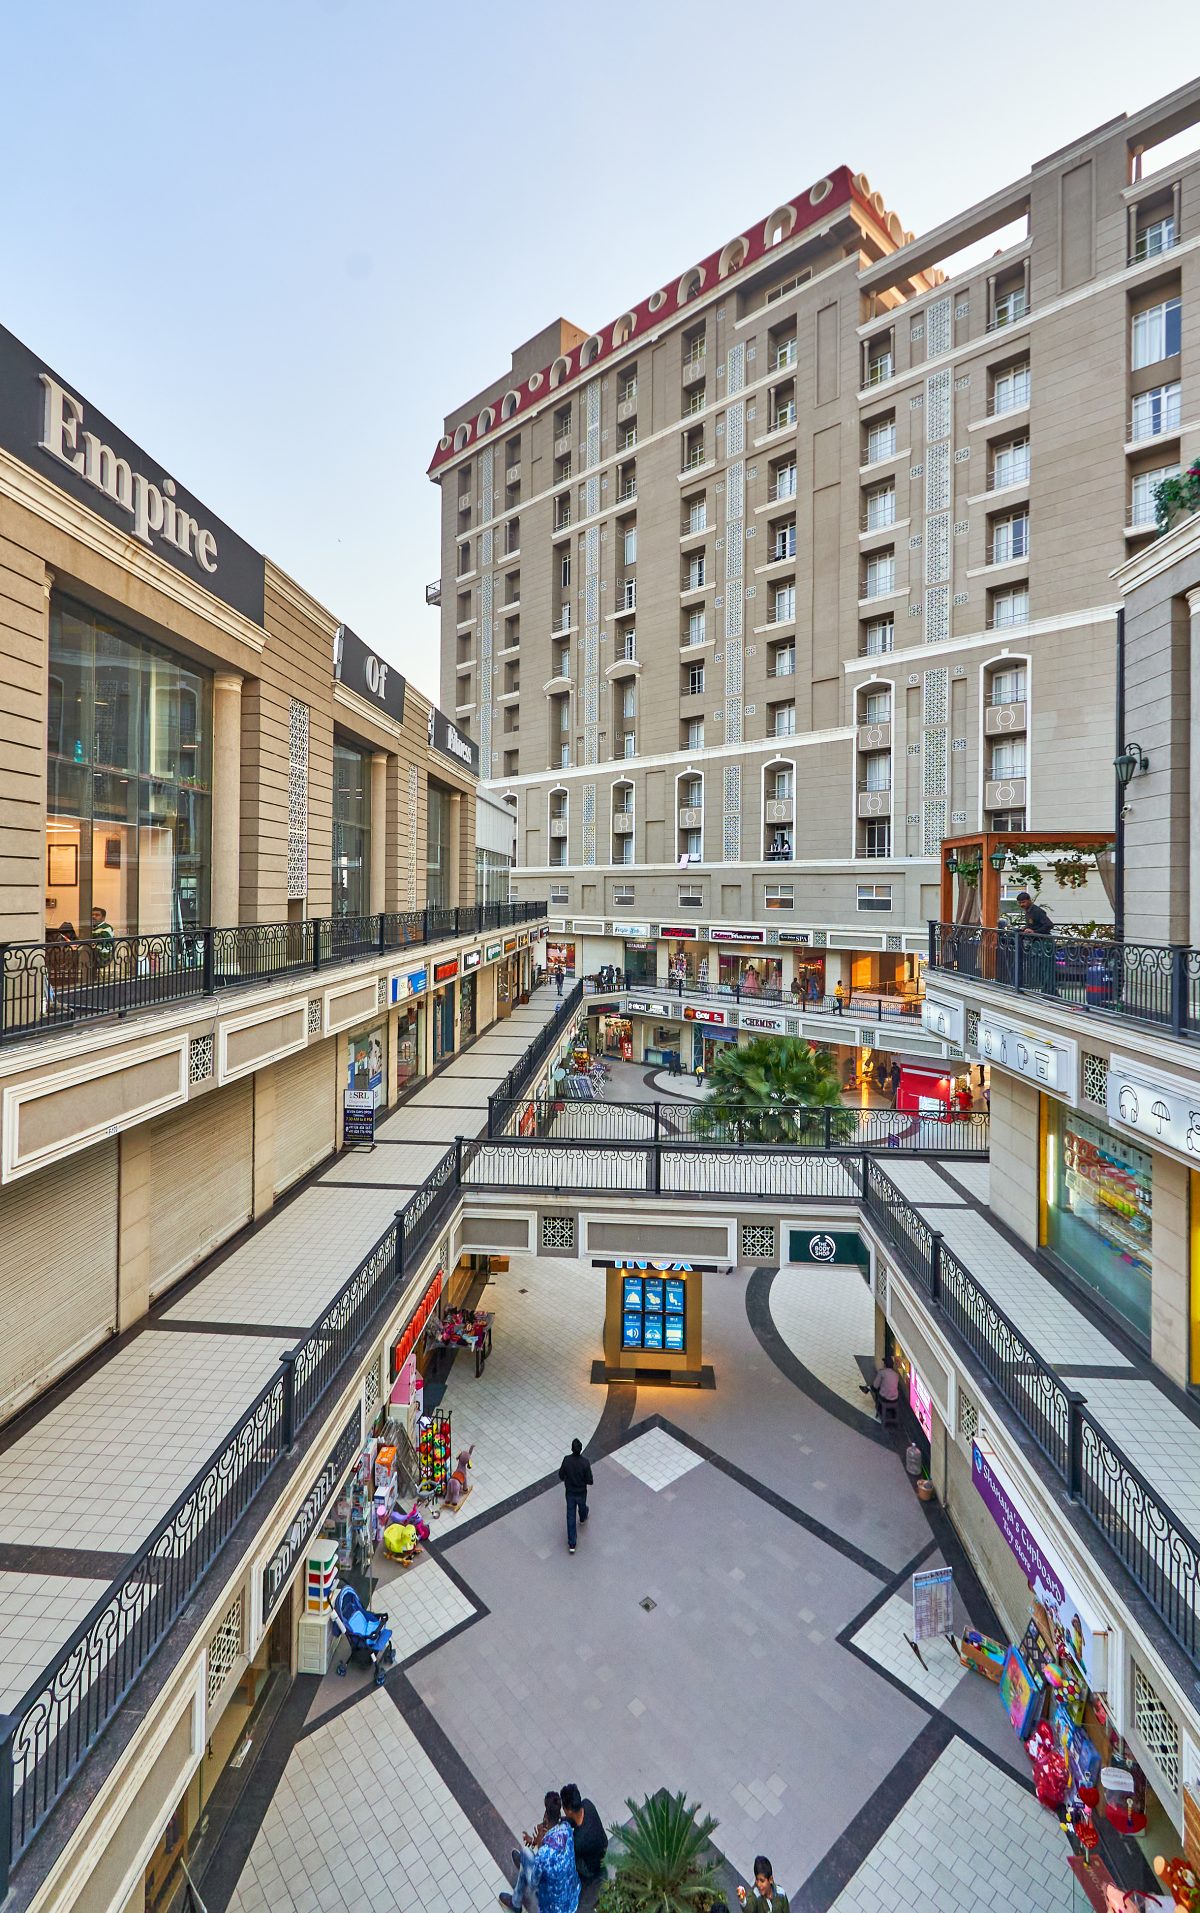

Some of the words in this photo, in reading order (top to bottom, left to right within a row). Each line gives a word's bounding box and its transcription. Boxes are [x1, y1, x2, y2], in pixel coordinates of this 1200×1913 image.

[38, 373, 217, 573] Empire
[365, 655, 388, 699] Of
[745, 1017, 776, 1029] CHEMIST
[270, 1463, 337, 1592] BOMBSHELL
[983, 1464, 1020, 1533] Shanaya's
[1002, 1516, 1014, 1544] Toy
